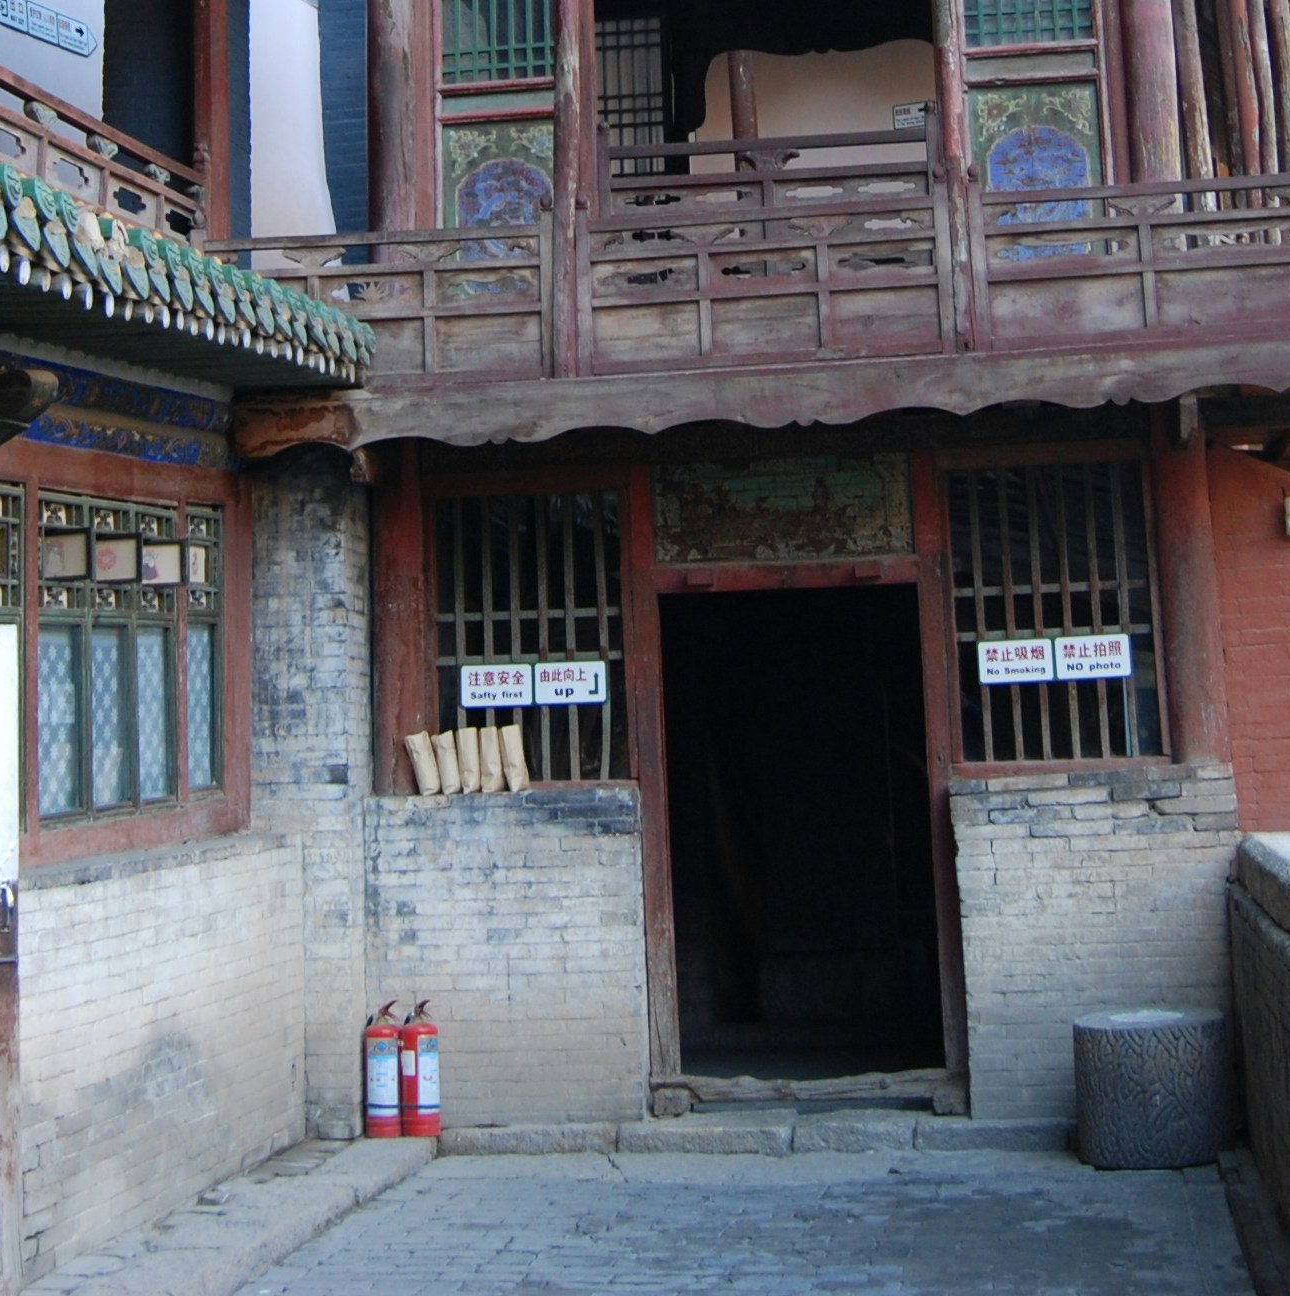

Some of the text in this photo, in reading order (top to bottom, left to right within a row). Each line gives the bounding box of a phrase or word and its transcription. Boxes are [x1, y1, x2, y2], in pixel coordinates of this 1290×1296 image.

[985, 645, 1046, 663] 禁止吸烟
[1063, 640, 1122, 659] 禁止拍照
[986, 665, 1046, 676] No Smoking
[1066, 661, 1121, 672] NO photo
[468, 670, 525, 687] 注意安全
[540, 667, 587, 683] 由此向上
[470, 690, 523, 701] Safty first
[554, 687, 575, 699] up
